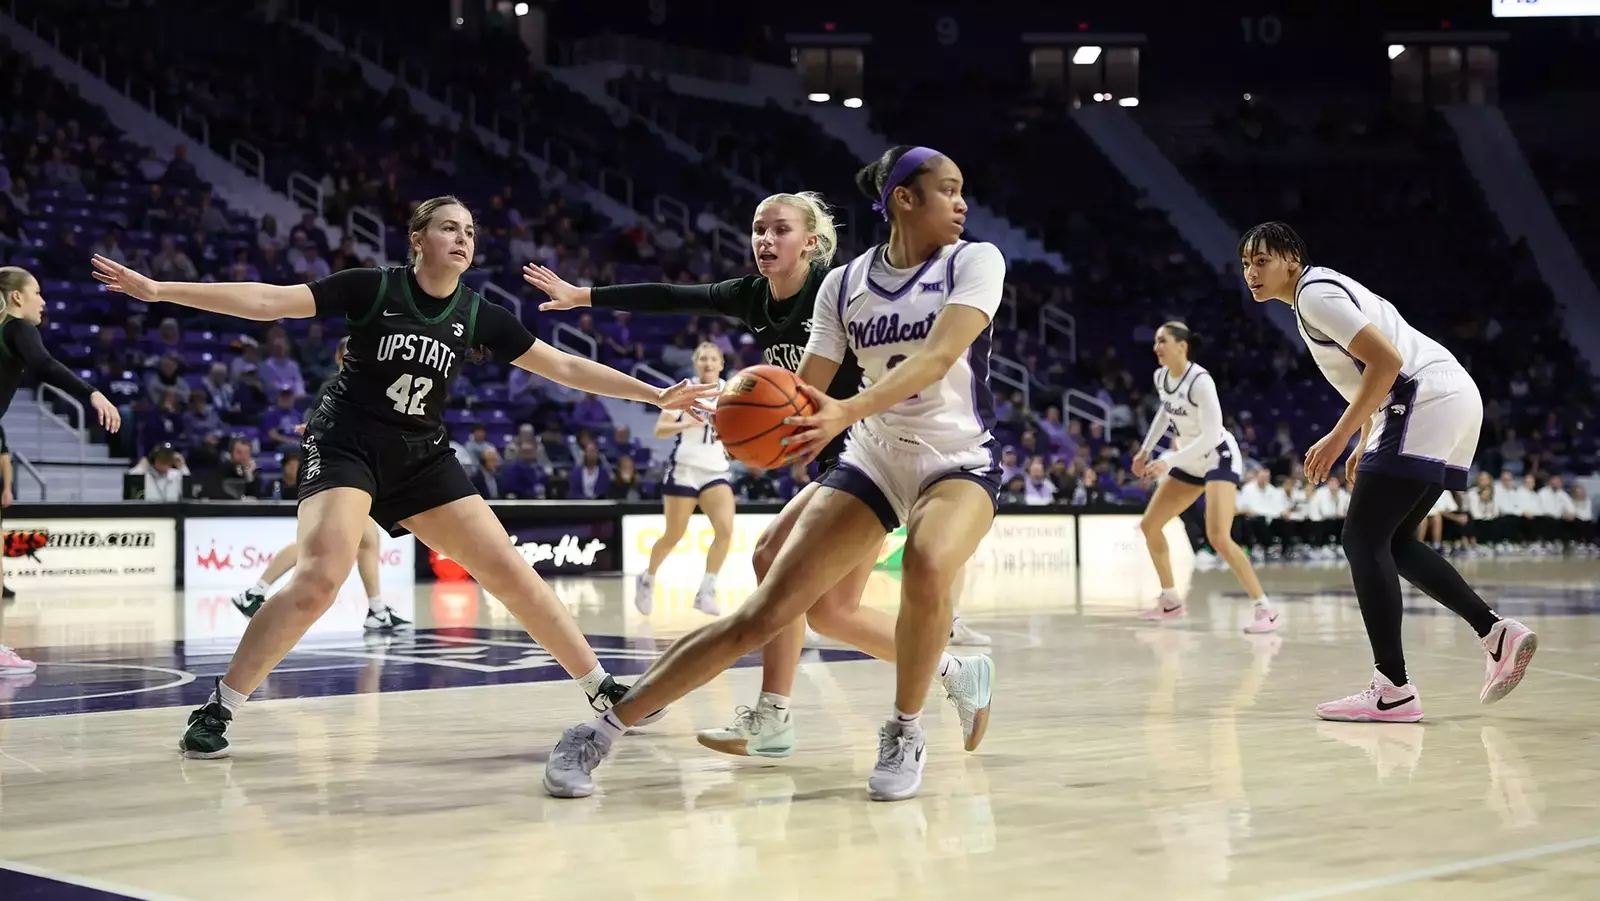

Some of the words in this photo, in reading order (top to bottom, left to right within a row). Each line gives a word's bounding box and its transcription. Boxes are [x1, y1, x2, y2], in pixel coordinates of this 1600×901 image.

[1240, 14, 1282, 46] 10
[848, 311, 938, 350] Wildcat
[377, 333, 456, 378] UPSTATE
[386, 373, 433, 415] 42
[553, 534, 606, 567] Hut
